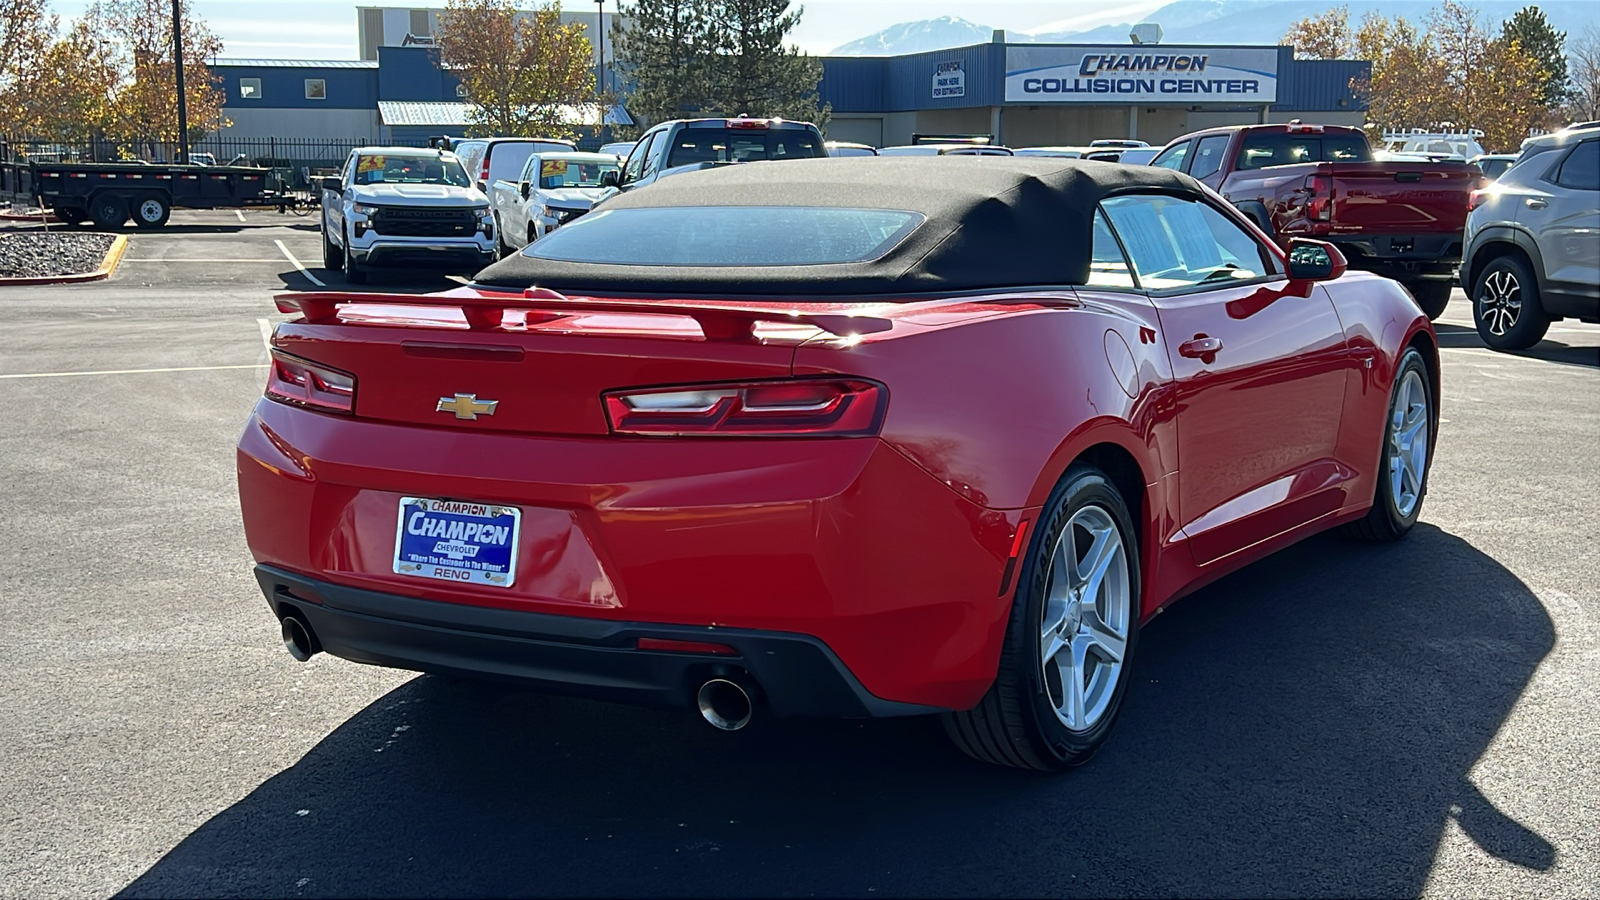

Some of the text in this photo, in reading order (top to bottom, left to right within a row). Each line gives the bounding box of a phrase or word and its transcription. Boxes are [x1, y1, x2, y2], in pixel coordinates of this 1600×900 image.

[1079, 54, 1209, 77] CHAMPION
[937, 77, 959, 86] PARK HERE
[1023, 78, 1259, 94] COLLISION CENTER
[933, 86, 963, 96] FOR ESTIMATES
[431, 501, 487, 516] CHAMPION
[407, 511, 510, 546] CHAMPION
[436, 543, 477, 555] CHEVROLET
[428, 555, 439, 564] The
[439, 556, 464, 568] Customer
[471, 560, 481, 569] The
[434, 567, 471, 580] RENO
